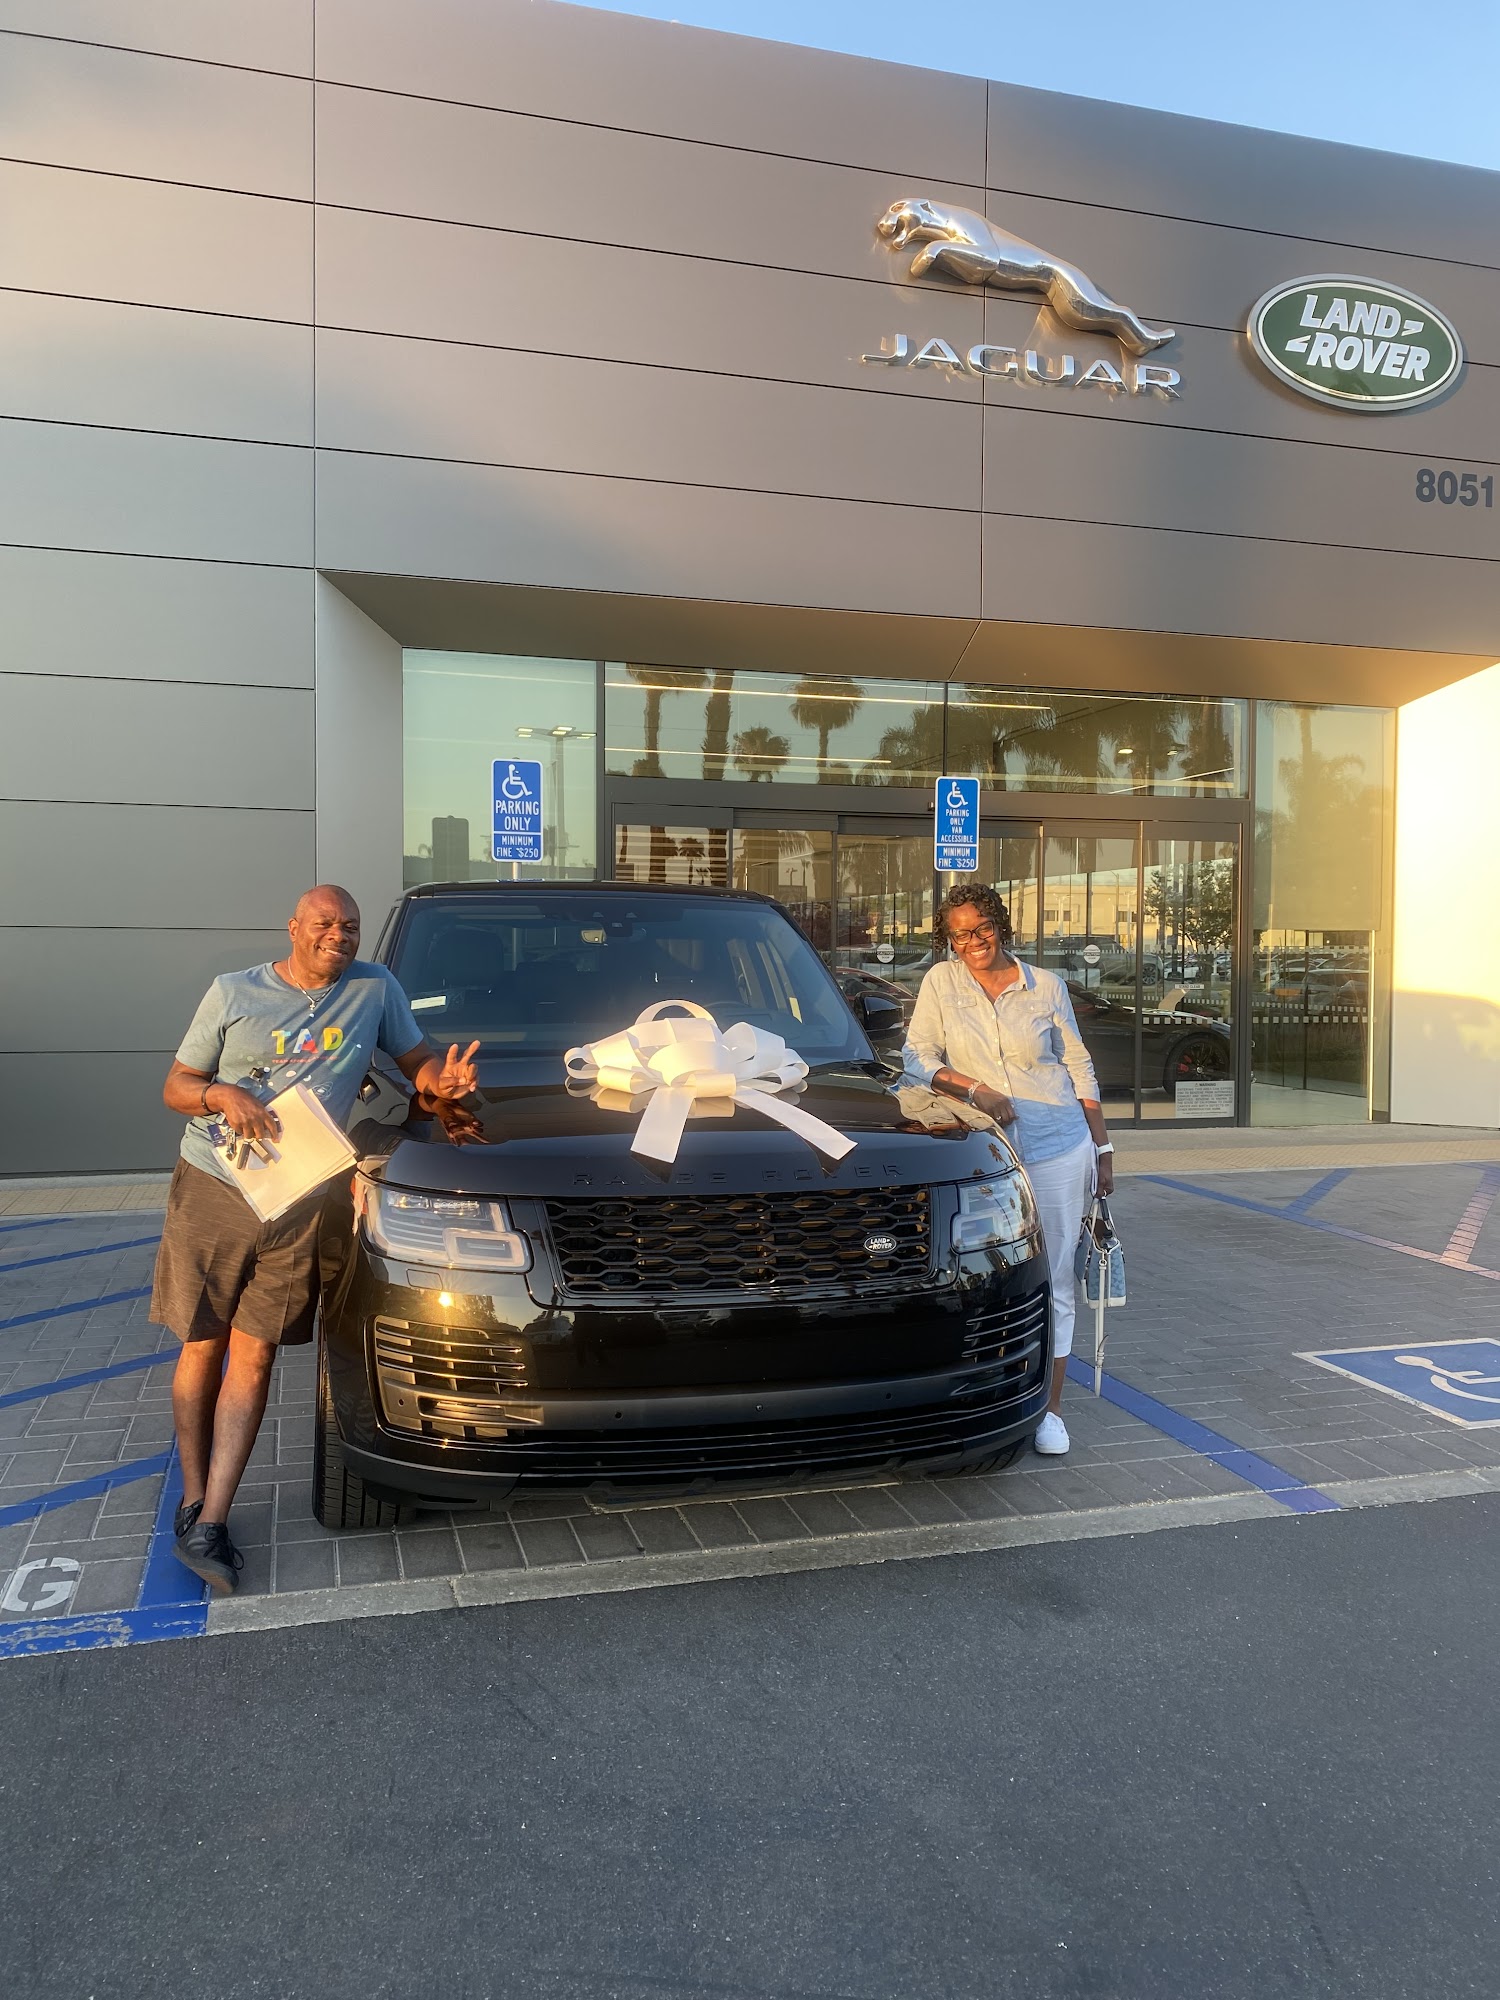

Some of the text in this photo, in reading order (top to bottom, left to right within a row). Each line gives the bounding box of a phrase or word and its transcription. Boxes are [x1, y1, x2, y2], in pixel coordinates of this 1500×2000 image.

[1299, 293, 1402, 338] LAND
[1306, 331, 1431, 382] ROVER
[861, 333, 1182, 399] JAGUAR
[1415, 468, 1494, 508] 8051
[495, 799, 540, 815] PARKING
[945, 808, 970, 817] PARKING
[504, 816, 531, 831] ONLY
[949, 817, 965, 826] ONLY
[951, 826, 963, 834] VAN
[501, 835, 534, 846] MINIMUM
[940, 834, 974, 843] ACCESSIBLE
[496, 847, 512, 857] FINE
[942, 847, 971, 857] MINIMUM
[938, 857, 952, 868] FINE
[271, 1026, 344, 1055] TAD
[573, 1170, 730, 1186] RANGE
[761, 1163, 904, 1182] ROVER
[870, 1237, 887, 1245] LAND
[872, 1242, 893, 1250] ROVER
[1, 1557, 80, 1612] G
